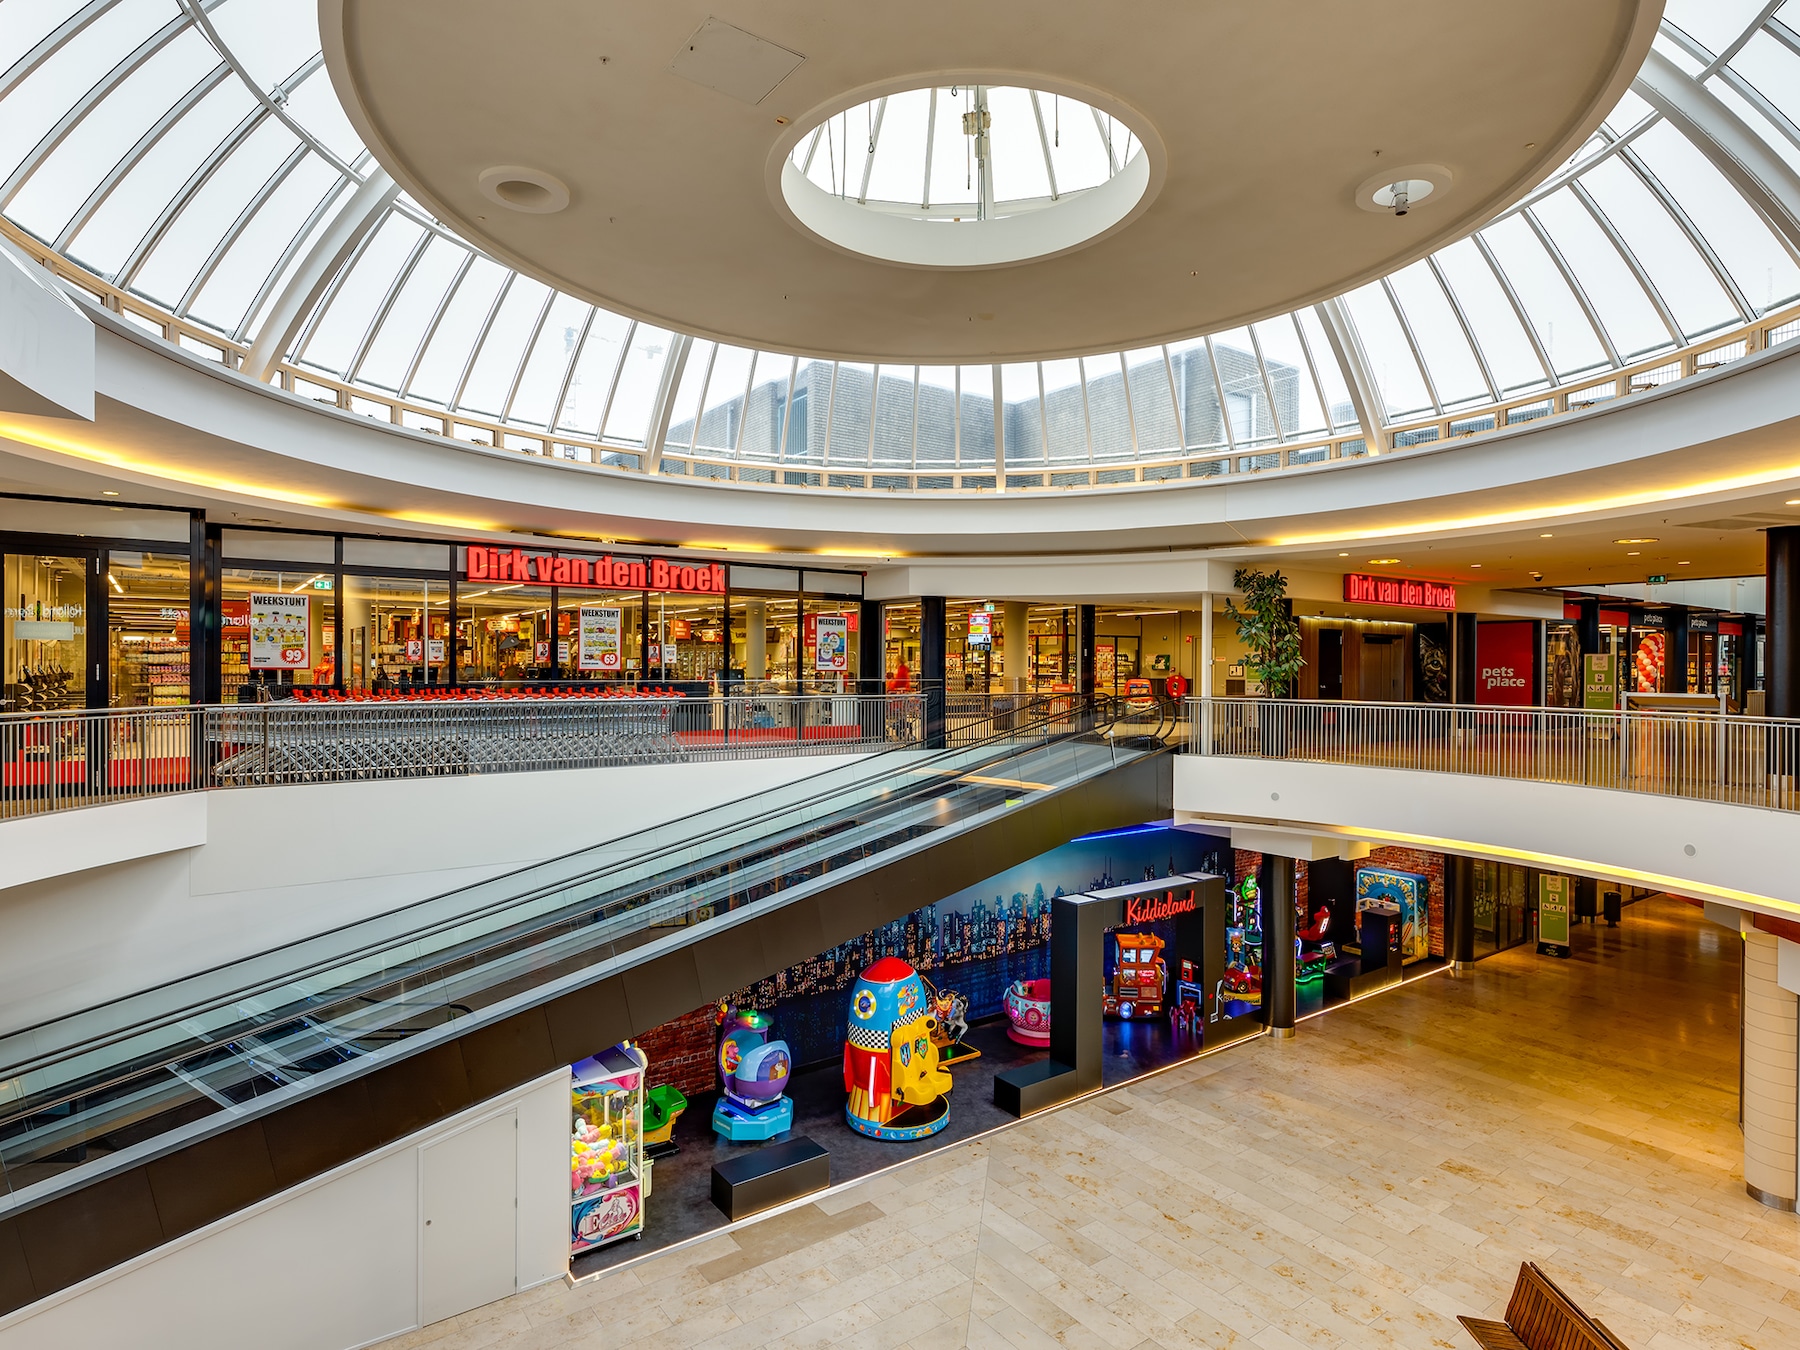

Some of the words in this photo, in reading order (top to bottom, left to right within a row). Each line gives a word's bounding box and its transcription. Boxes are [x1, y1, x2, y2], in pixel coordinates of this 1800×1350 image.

[467, 545, 531, 581] Dirk
[535, 555, 589, 584] van
[594, 555, 647, 587] den
[650, 558, 726, 593] Broek
[1349, 574, 1376, 601] Dirk
[1377, 581, 1400, 603] van
[1401, 580, 1423, 605] den
[1424, 582, 1456, 608] Broek
[253, 595, 307, 607] WEEKSTUNT
[581, 608, 619, 618] WEEKSTUNT
[818, 618, 846, 626] WEEKSTUNT
[285, 649, 302, 662] 99
[604, 653, 616, 665] 69
[1482, 666, 1514, 679] pets
[1487, 677, 1526, 690] place
[1126, 889, 1196, 925] Kiddieland
